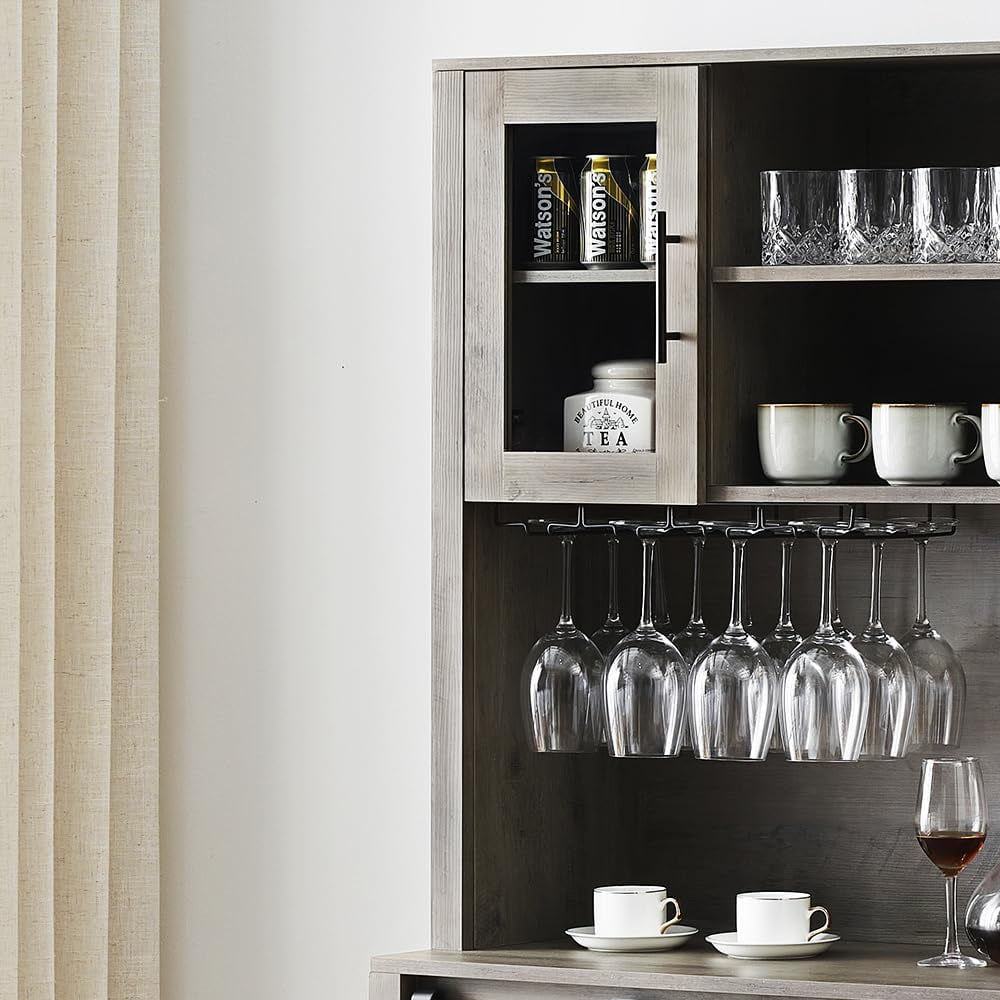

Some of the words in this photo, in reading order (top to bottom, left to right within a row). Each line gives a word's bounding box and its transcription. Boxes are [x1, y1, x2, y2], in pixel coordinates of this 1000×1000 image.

[534, 173, 552, 257] Watson's
[591, 172, 607, 257] Watson's
[574, 399, 614, 424] BEAUTIFUL
[616, 401, 639, 425] HOME
[583, 431, 628, 446] TEA
